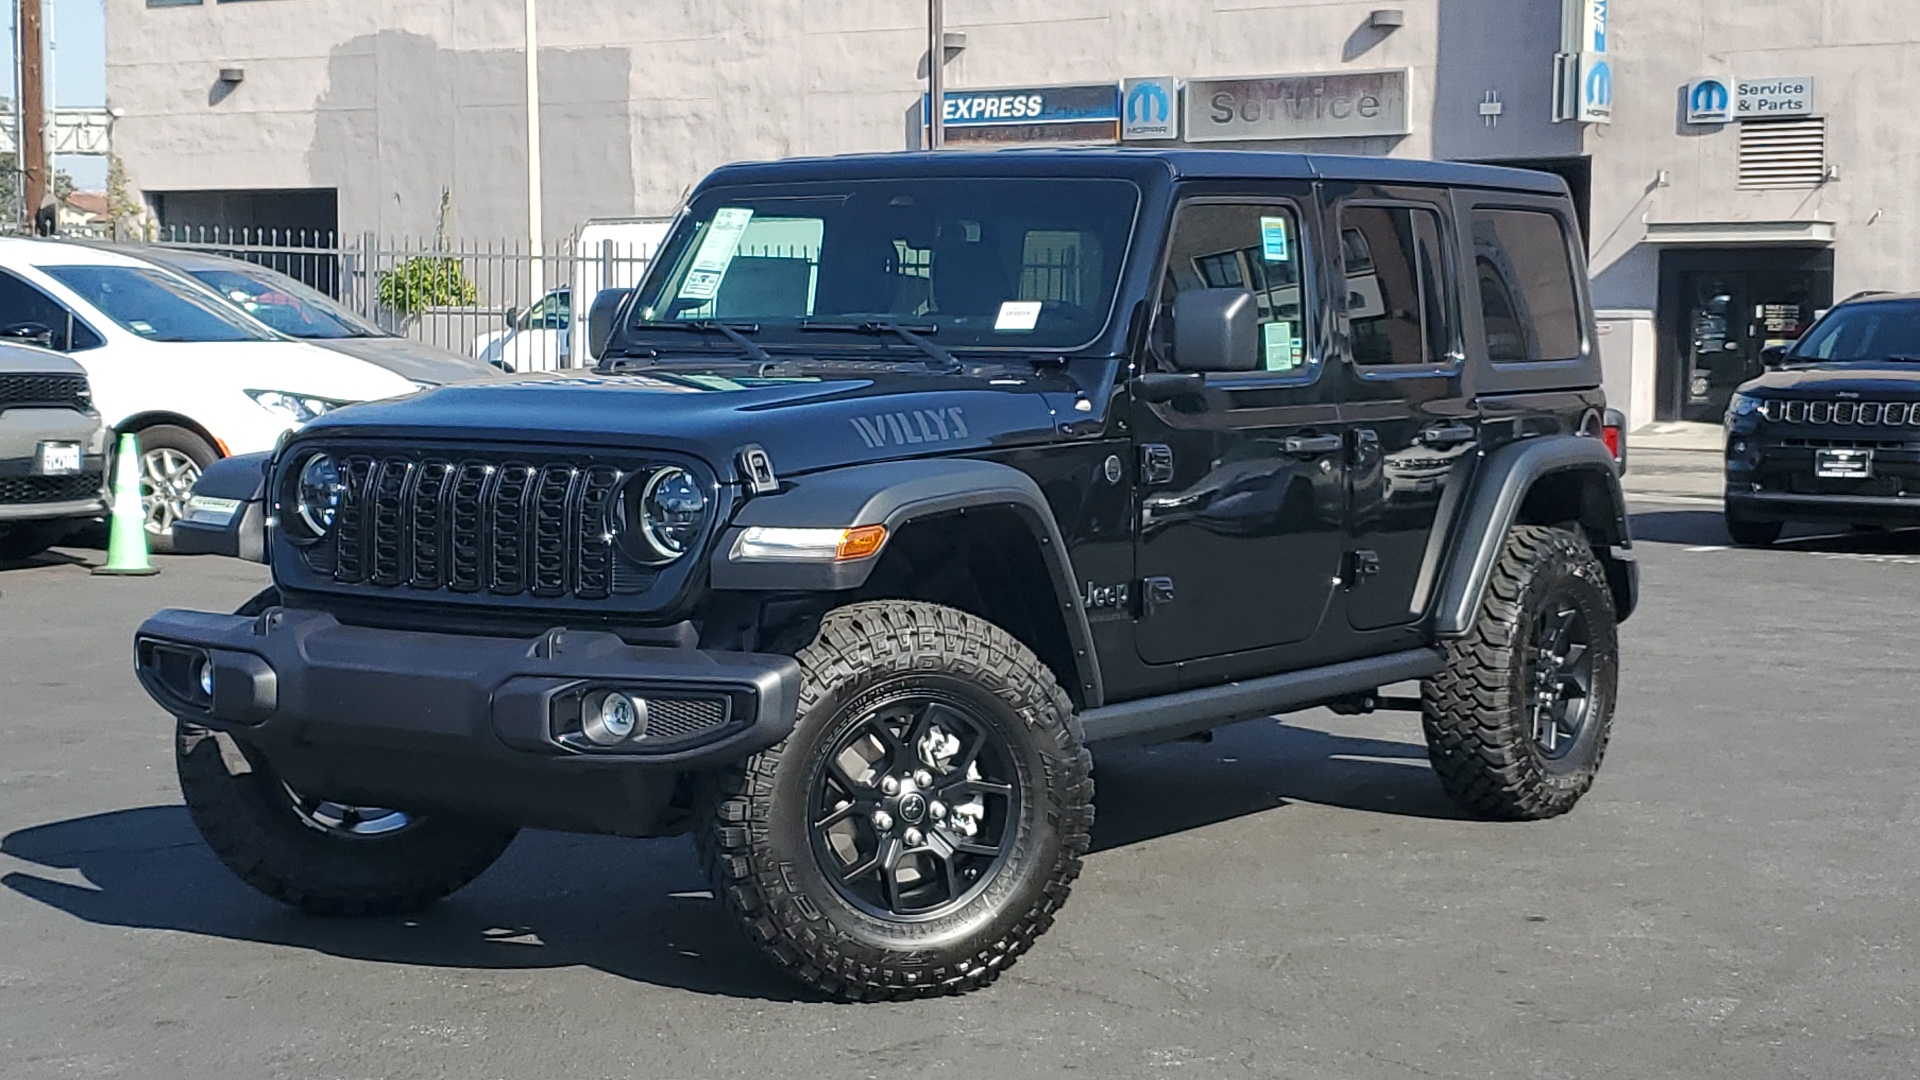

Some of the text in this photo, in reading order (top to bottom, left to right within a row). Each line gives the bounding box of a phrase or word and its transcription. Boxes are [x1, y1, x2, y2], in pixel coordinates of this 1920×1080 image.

[1738, 82, 1804, 96] Service
[943, 95, 1043, 119] EXPRESS
[1210, 92, 1380, 123] Service
[1738, 99, 1803, 111] & Parts
[849, 406, 969, 448] WILLYS
[1080, 581, 1128, 608] Jeep
